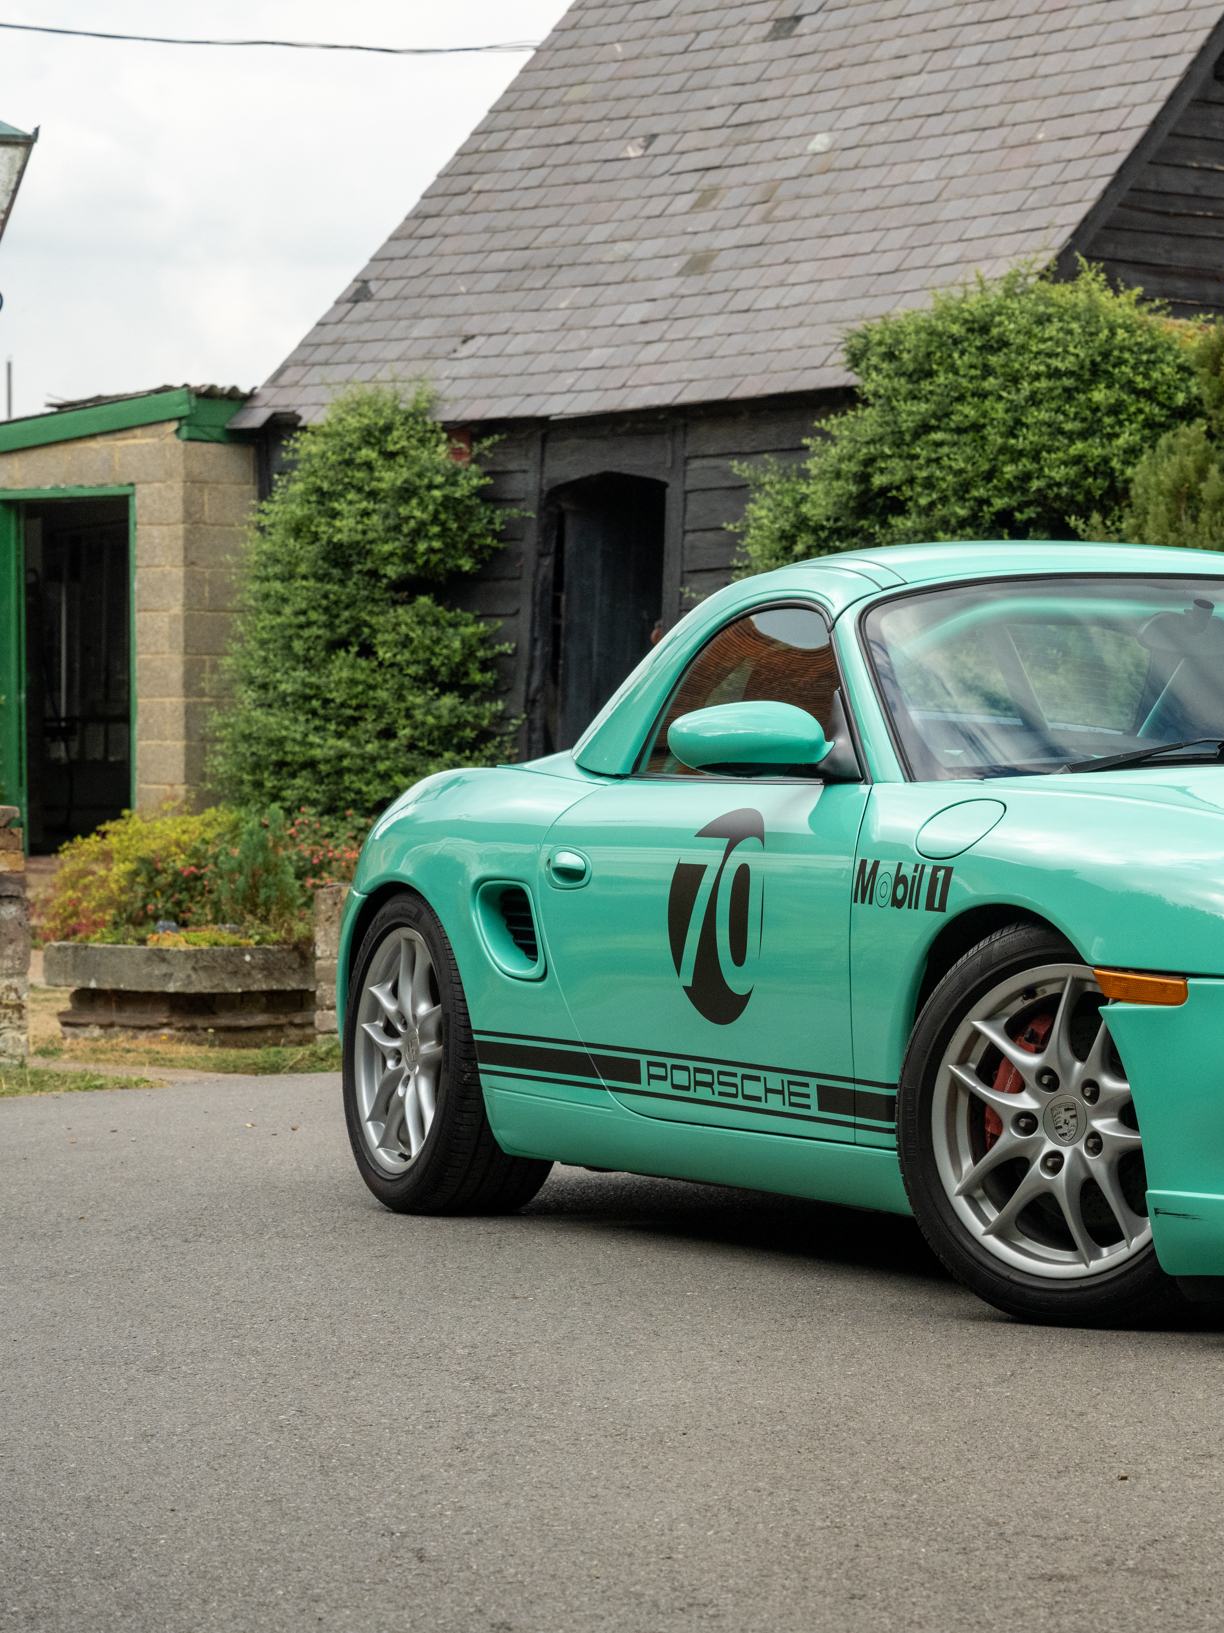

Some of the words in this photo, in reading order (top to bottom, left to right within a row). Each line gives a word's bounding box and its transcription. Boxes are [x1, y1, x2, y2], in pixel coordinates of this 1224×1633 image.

[853, 858, 926, 910] Mobil
[679, 836, 764, 996] 70
[646, 1060, 812, 1110] PORSCHE
